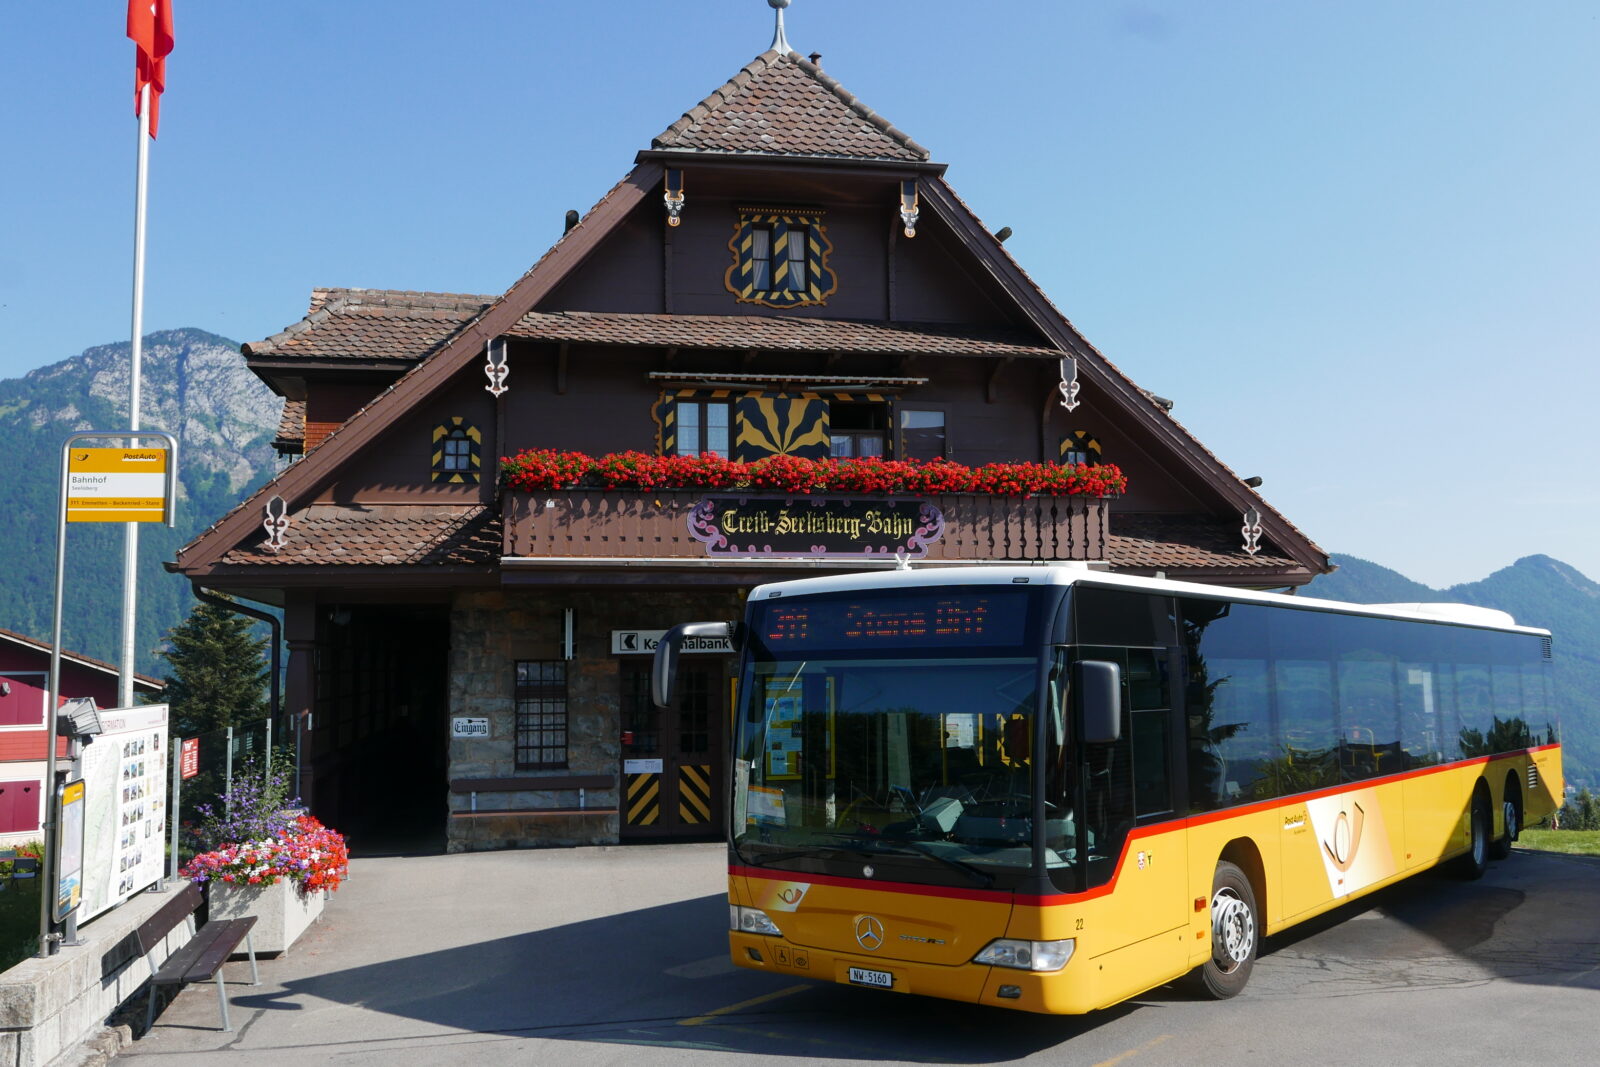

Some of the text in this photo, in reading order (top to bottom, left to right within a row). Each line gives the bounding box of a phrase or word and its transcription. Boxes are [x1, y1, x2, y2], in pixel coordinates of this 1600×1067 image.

[72, 476, 107, 484] Bahnhof
[644, 638, 730, 650] Kanalbank
[455, 721, 487, 735] Eingang
[1075, 918, 1084, 930] 22
[868, 971, 887, 984] 5160
